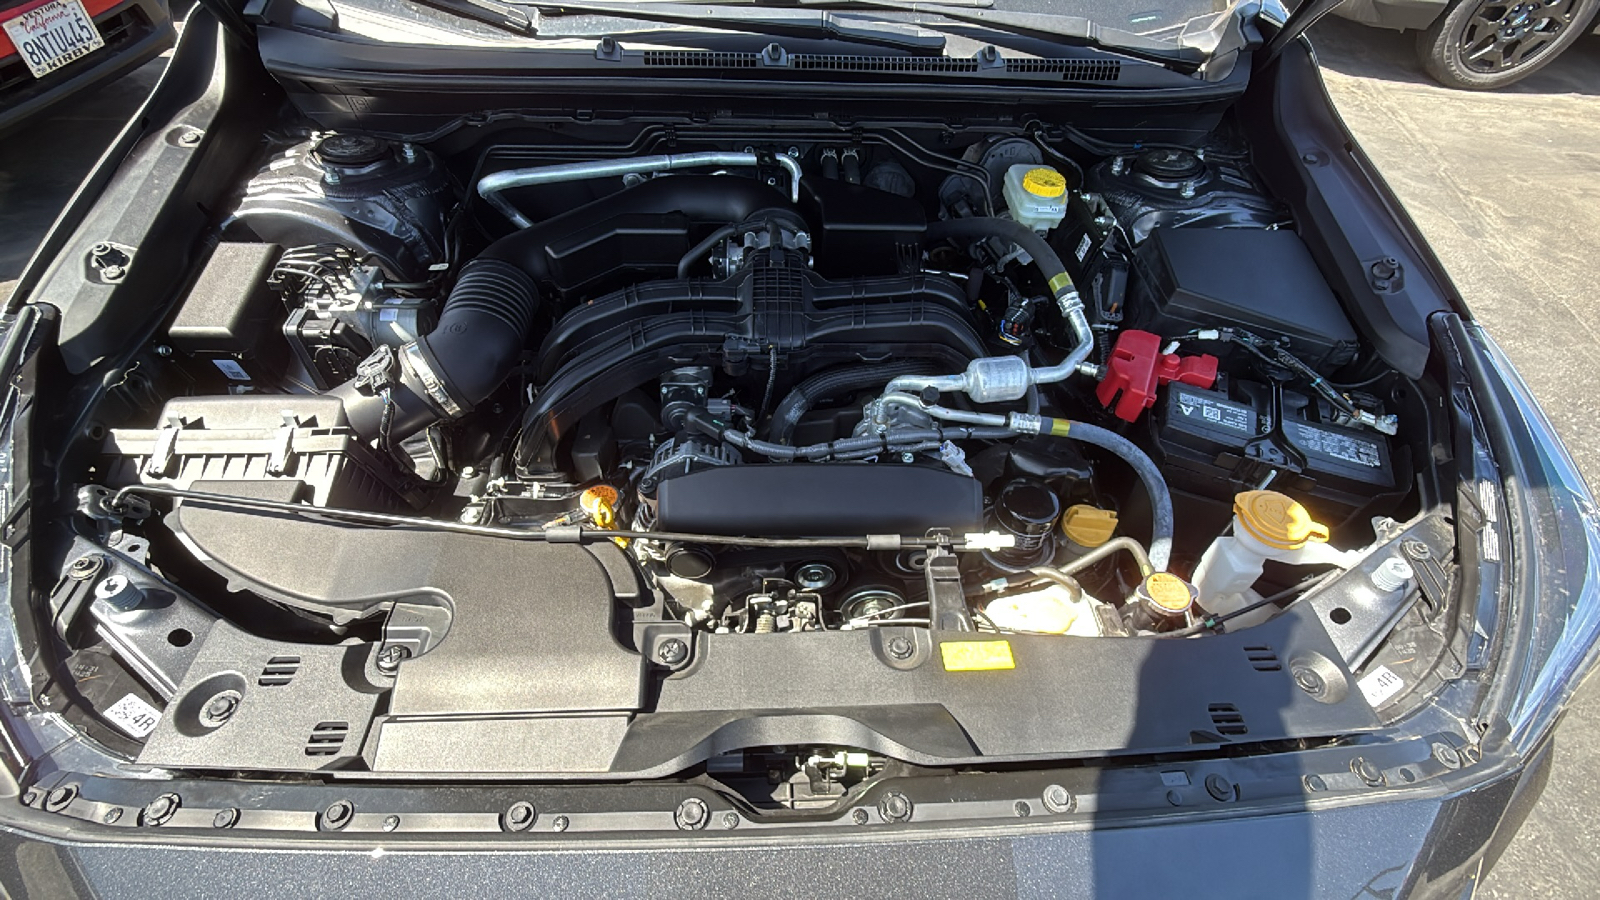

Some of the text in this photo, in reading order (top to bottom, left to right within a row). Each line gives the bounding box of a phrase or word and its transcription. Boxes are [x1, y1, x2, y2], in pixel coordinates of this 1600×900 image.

[22, 1, 62, 21] VENTURA
[24, 10, 70, 34] California
[23, 17, 93, 66] 8NTU445
[47, 43, 91, 71] KIRBY
[1378, 671, 1398, 688] 4R
[132, 713, 156, 732] 4R
